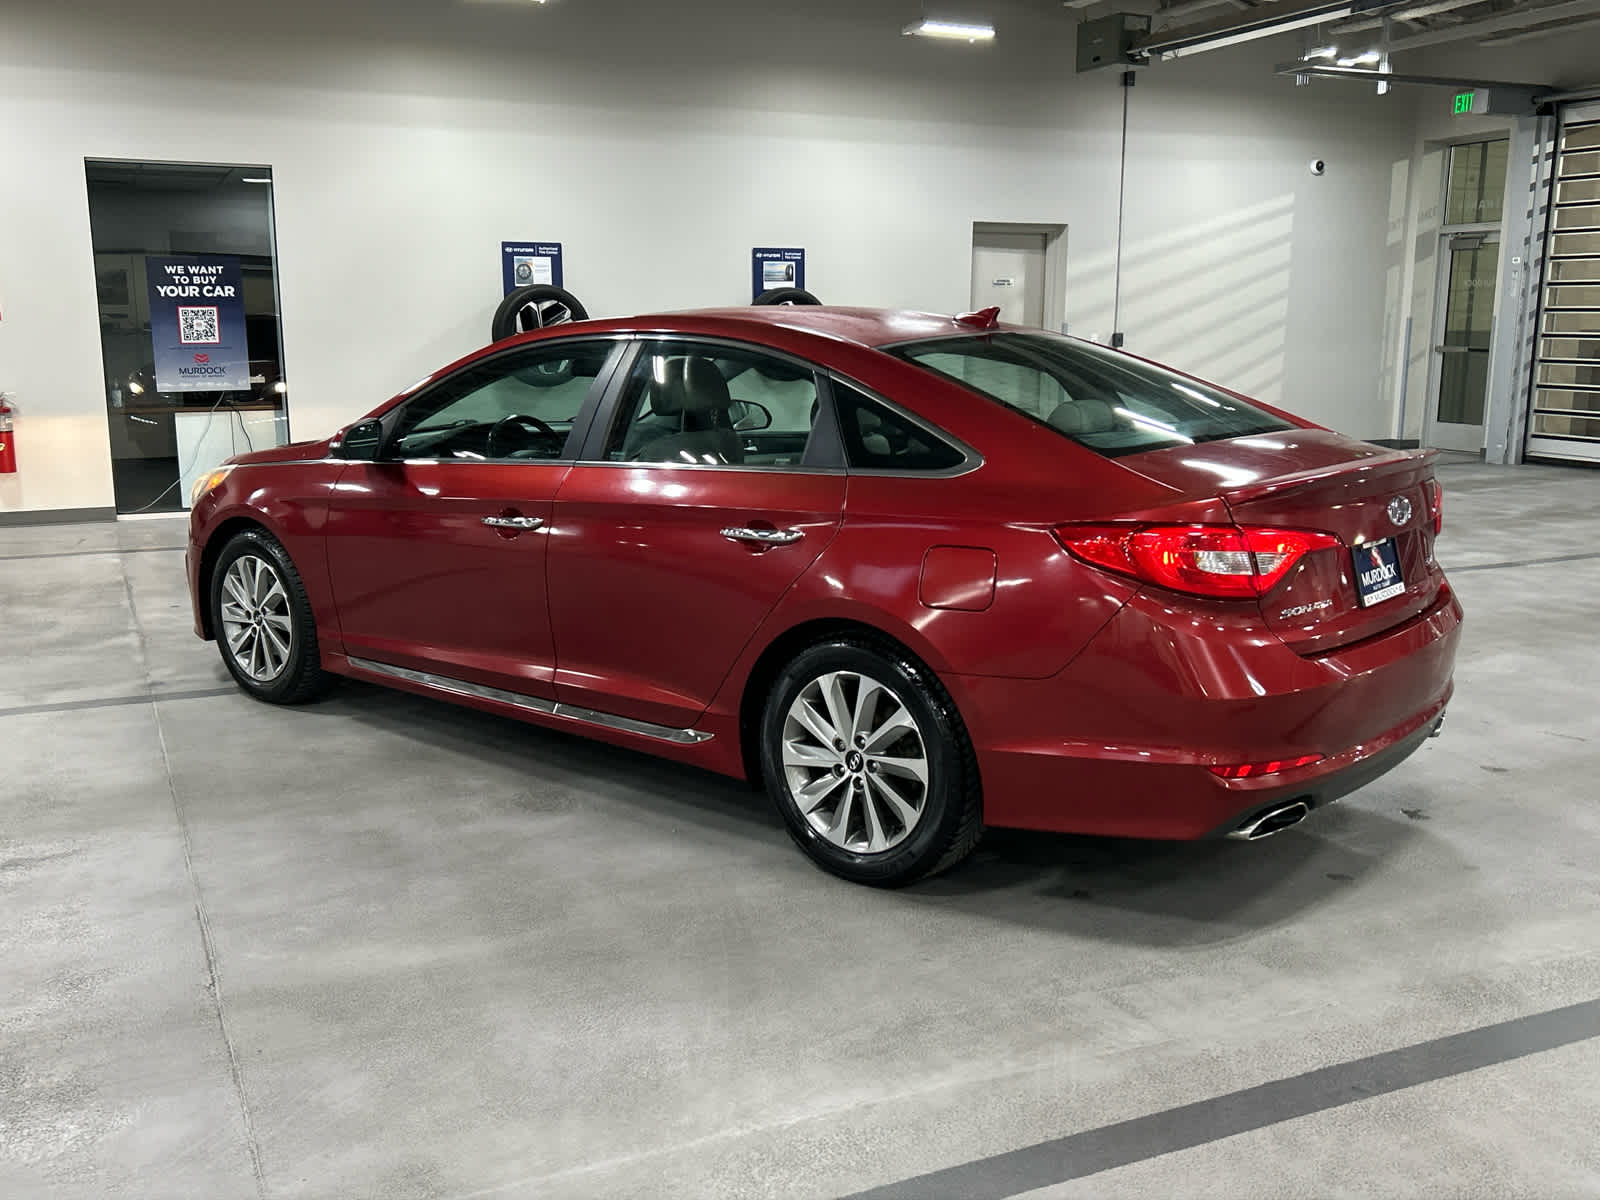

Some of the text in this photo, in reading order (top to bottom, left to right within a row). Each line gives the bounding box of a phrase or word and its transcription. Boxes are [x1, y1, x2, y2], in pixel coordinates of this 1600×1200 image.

[1454, 92, 1474, 114] EXIT
[164, 265, 224, 274] WE WANT
[173, 275, 217, 284] TO BUY
[156, 285, 235, 297] YOUR CAR
[178, 366, 226, 375] MURDOCK
[1361, 562, 1397, 587] MURDOCK
